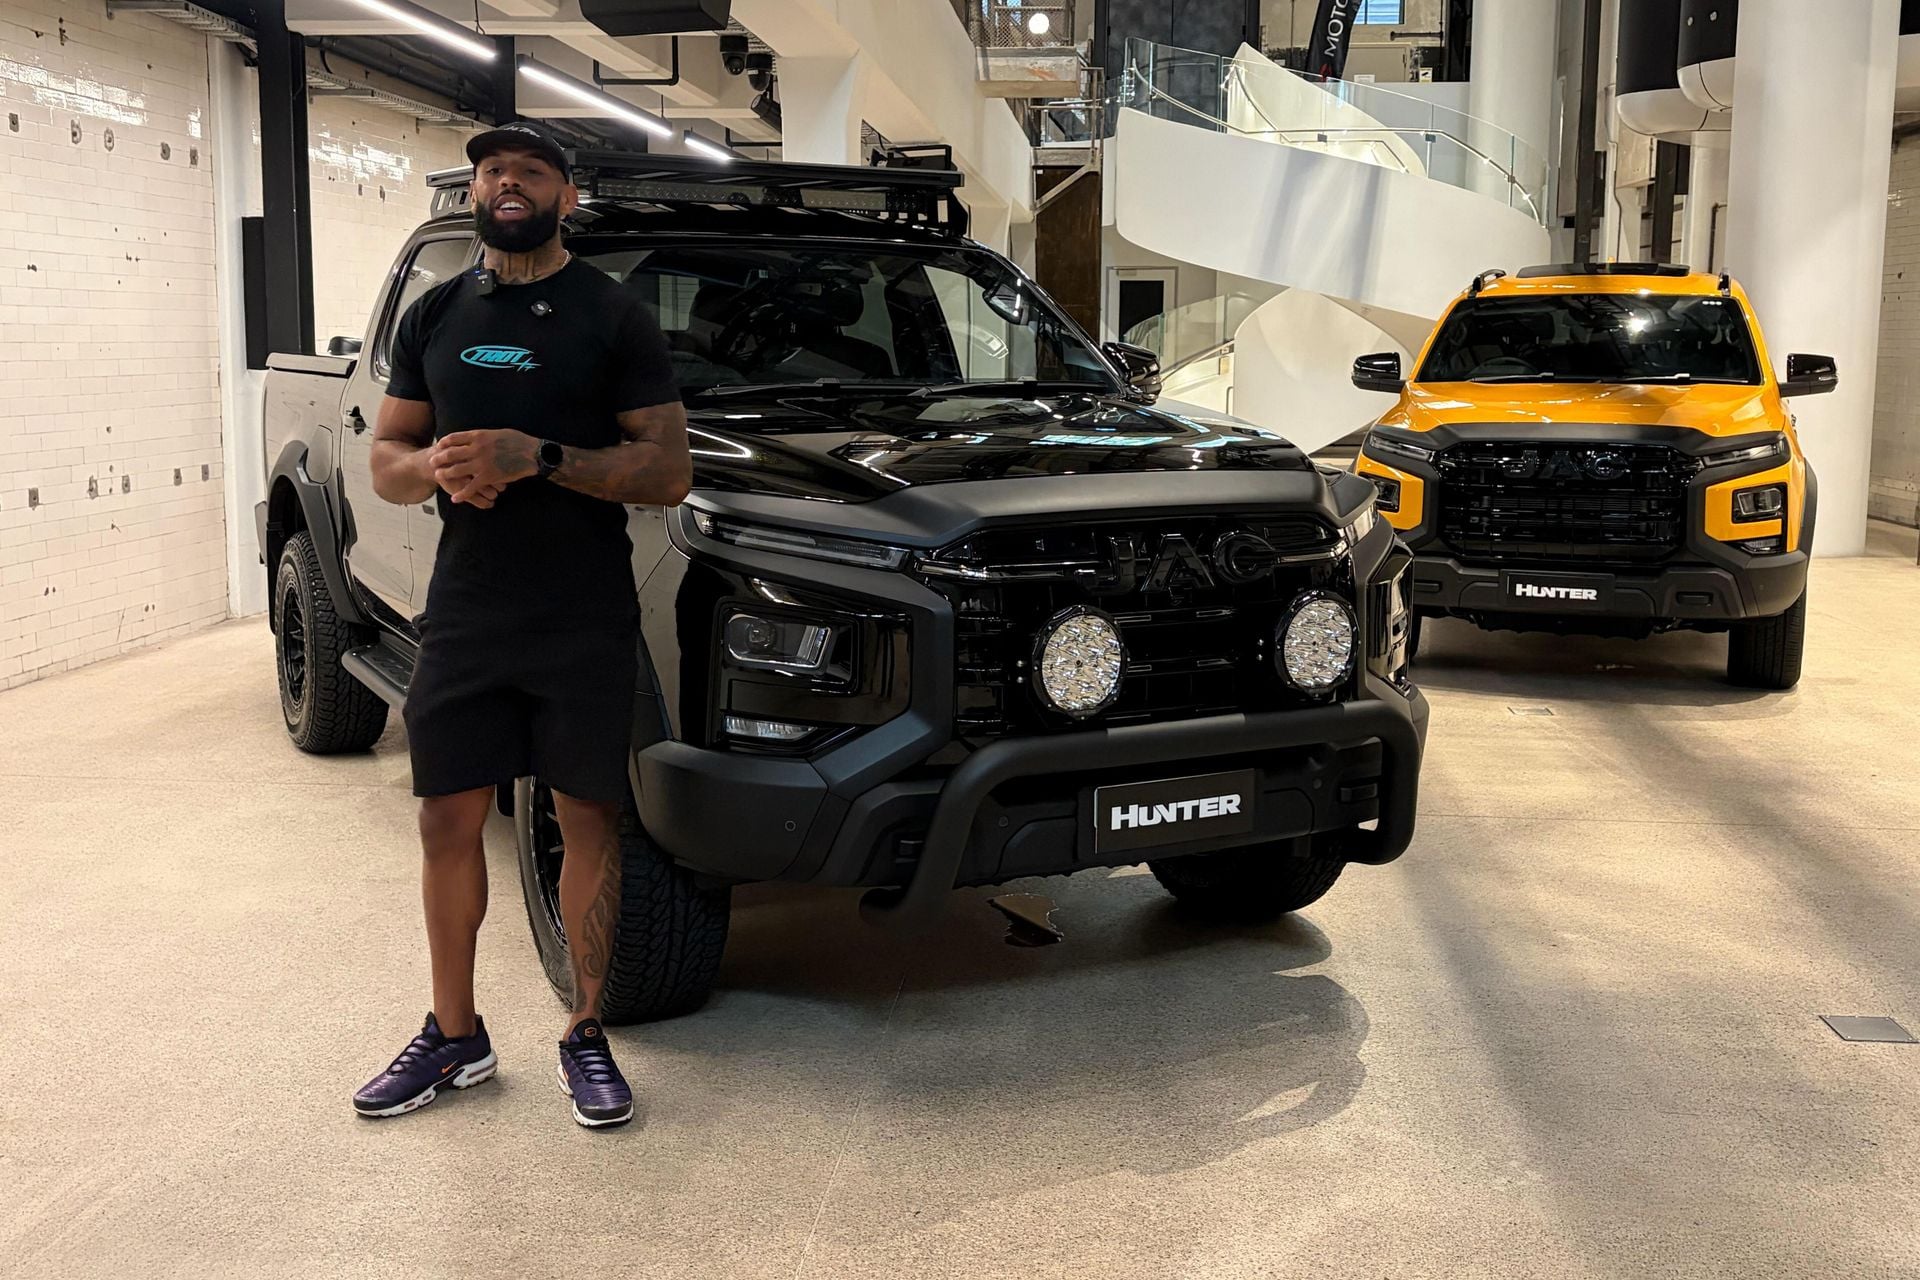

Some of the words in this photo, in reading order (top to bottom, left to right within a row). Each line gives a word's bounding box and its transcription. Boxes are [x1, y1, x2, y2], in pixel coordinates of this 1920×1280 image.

[1073, 530, 1275, 596] JAC
[1515, 583, 1598, 601] HUNTER
[1111, 793, 1241, 831] HUNTER
